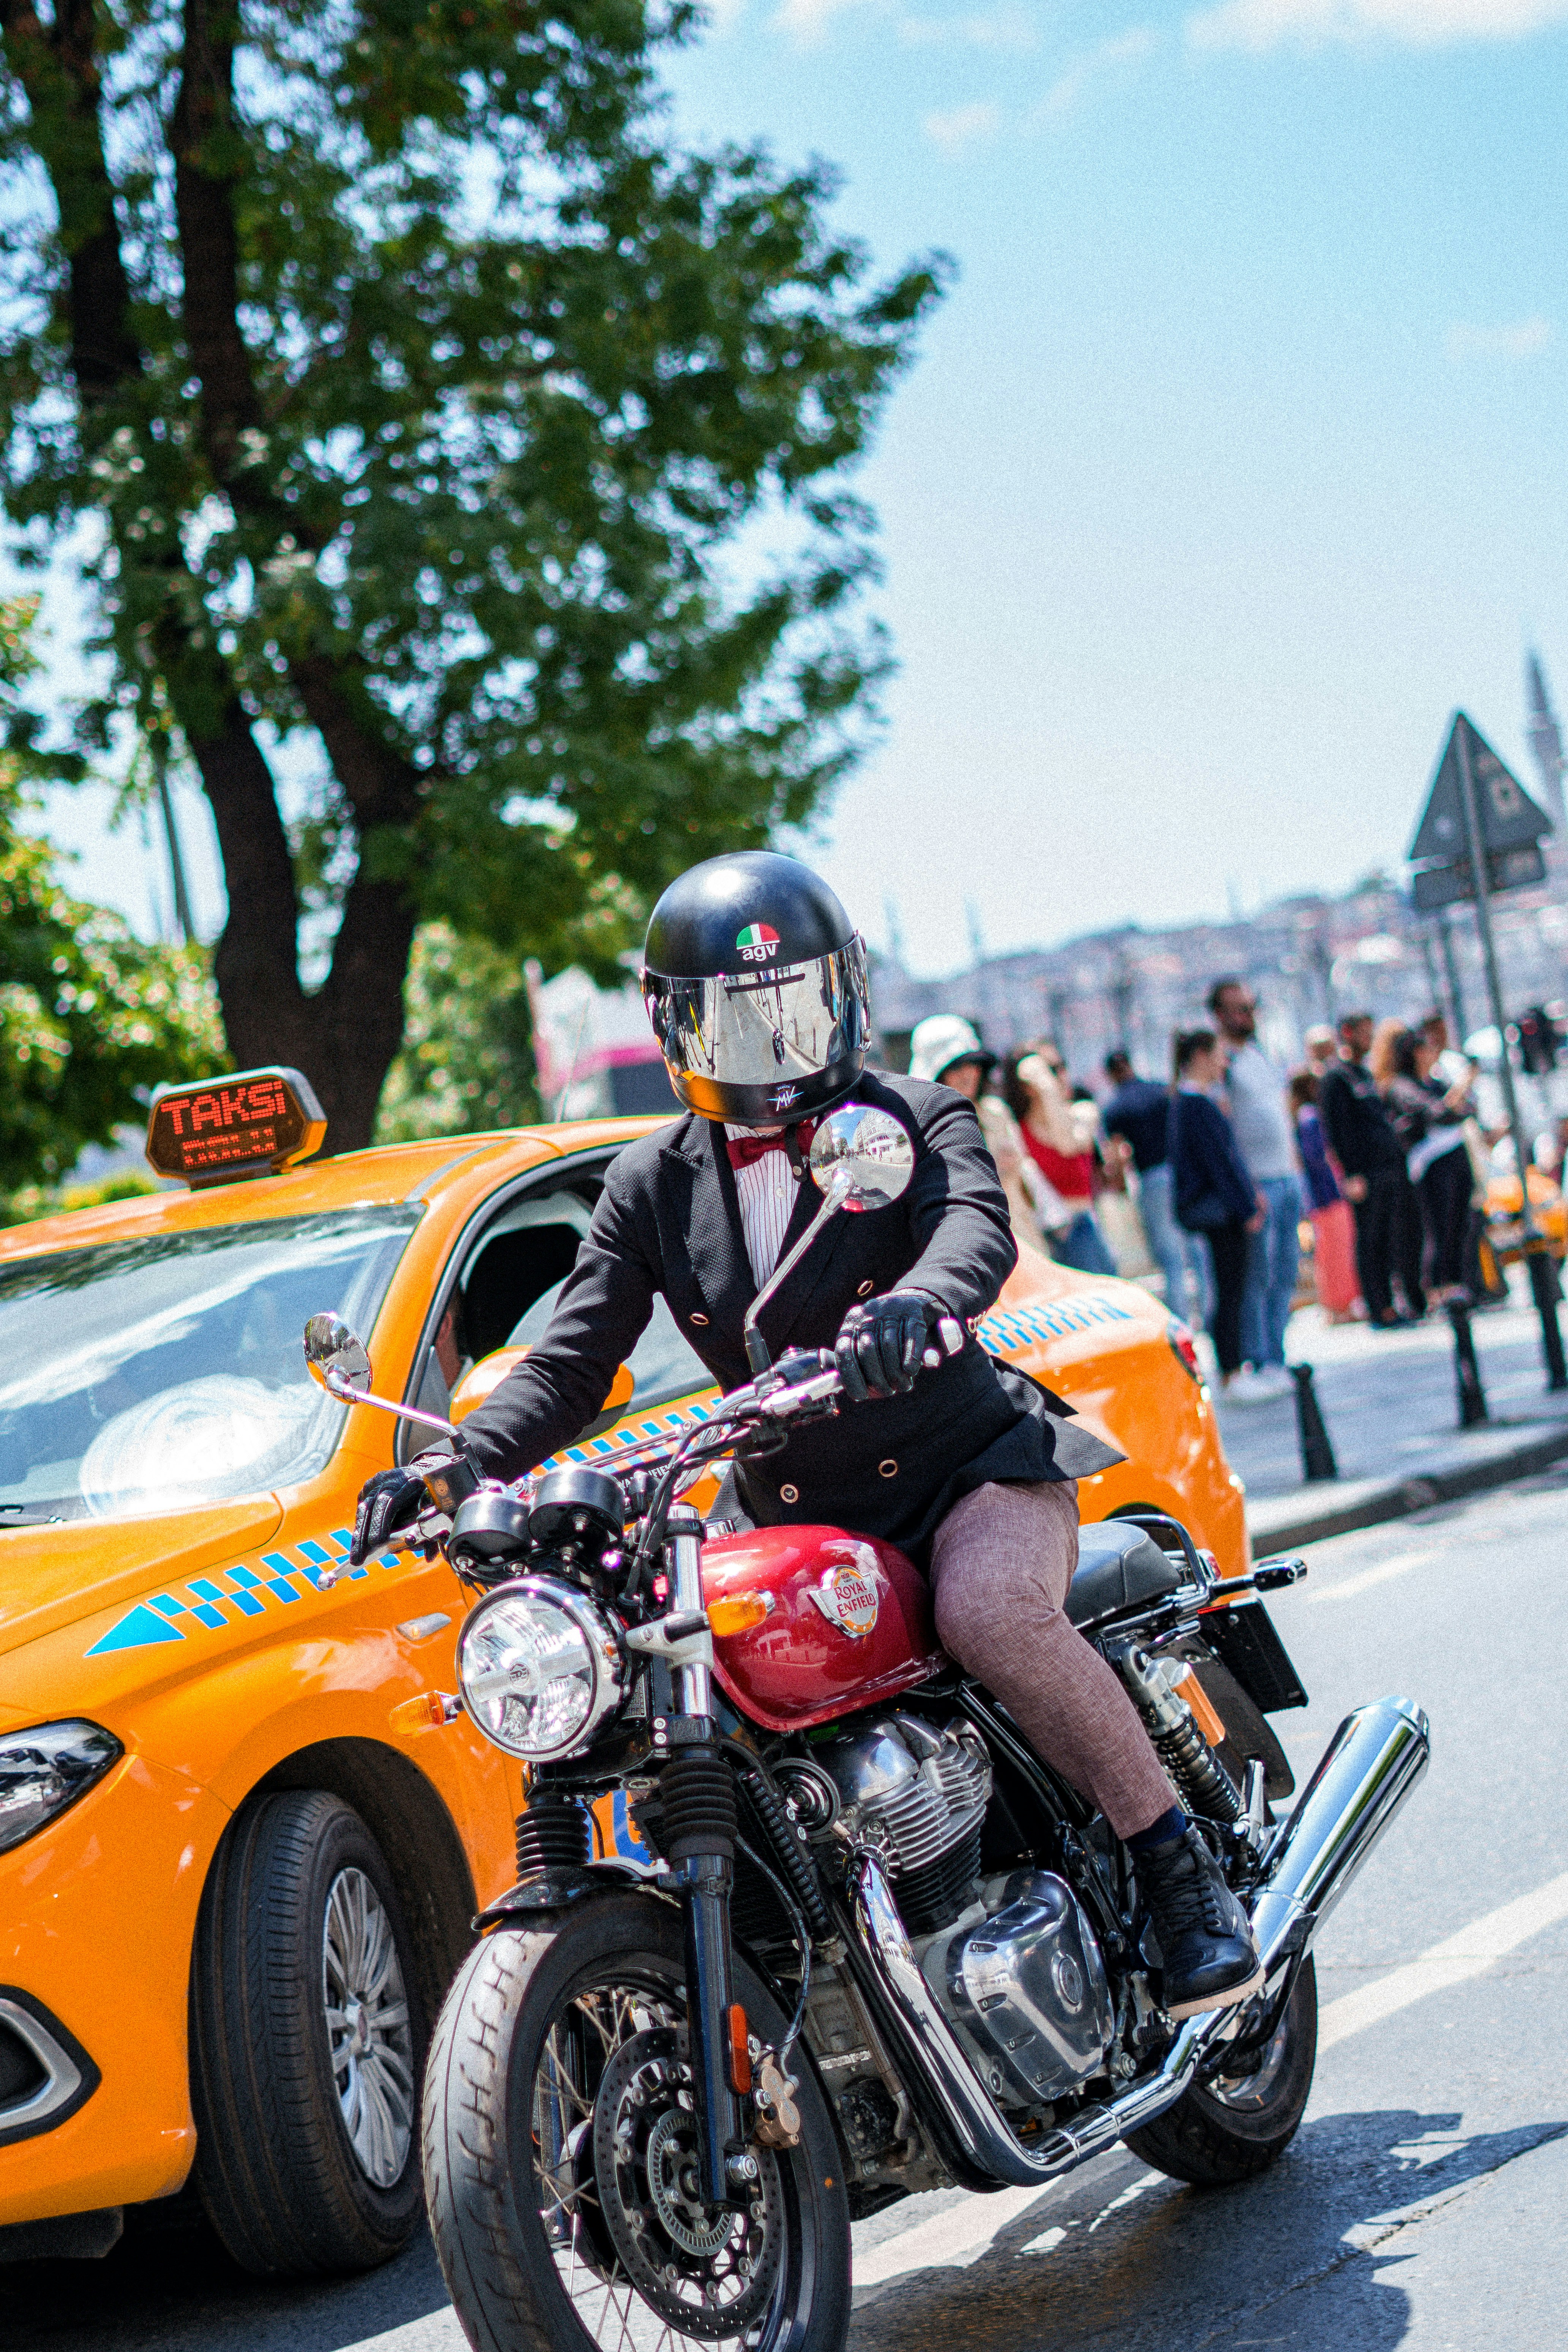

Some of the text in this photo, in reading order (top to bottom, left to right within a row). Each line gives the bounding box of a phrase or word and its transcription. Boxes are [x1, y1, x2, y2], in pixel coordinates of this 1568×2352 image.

[742, 943, 777, 961] agv
[776, 1086, 795, 1111] MV
[833, 1580, 868, 1601] ROYAL
[836, 1593, 876, 1618] ENFIELD
